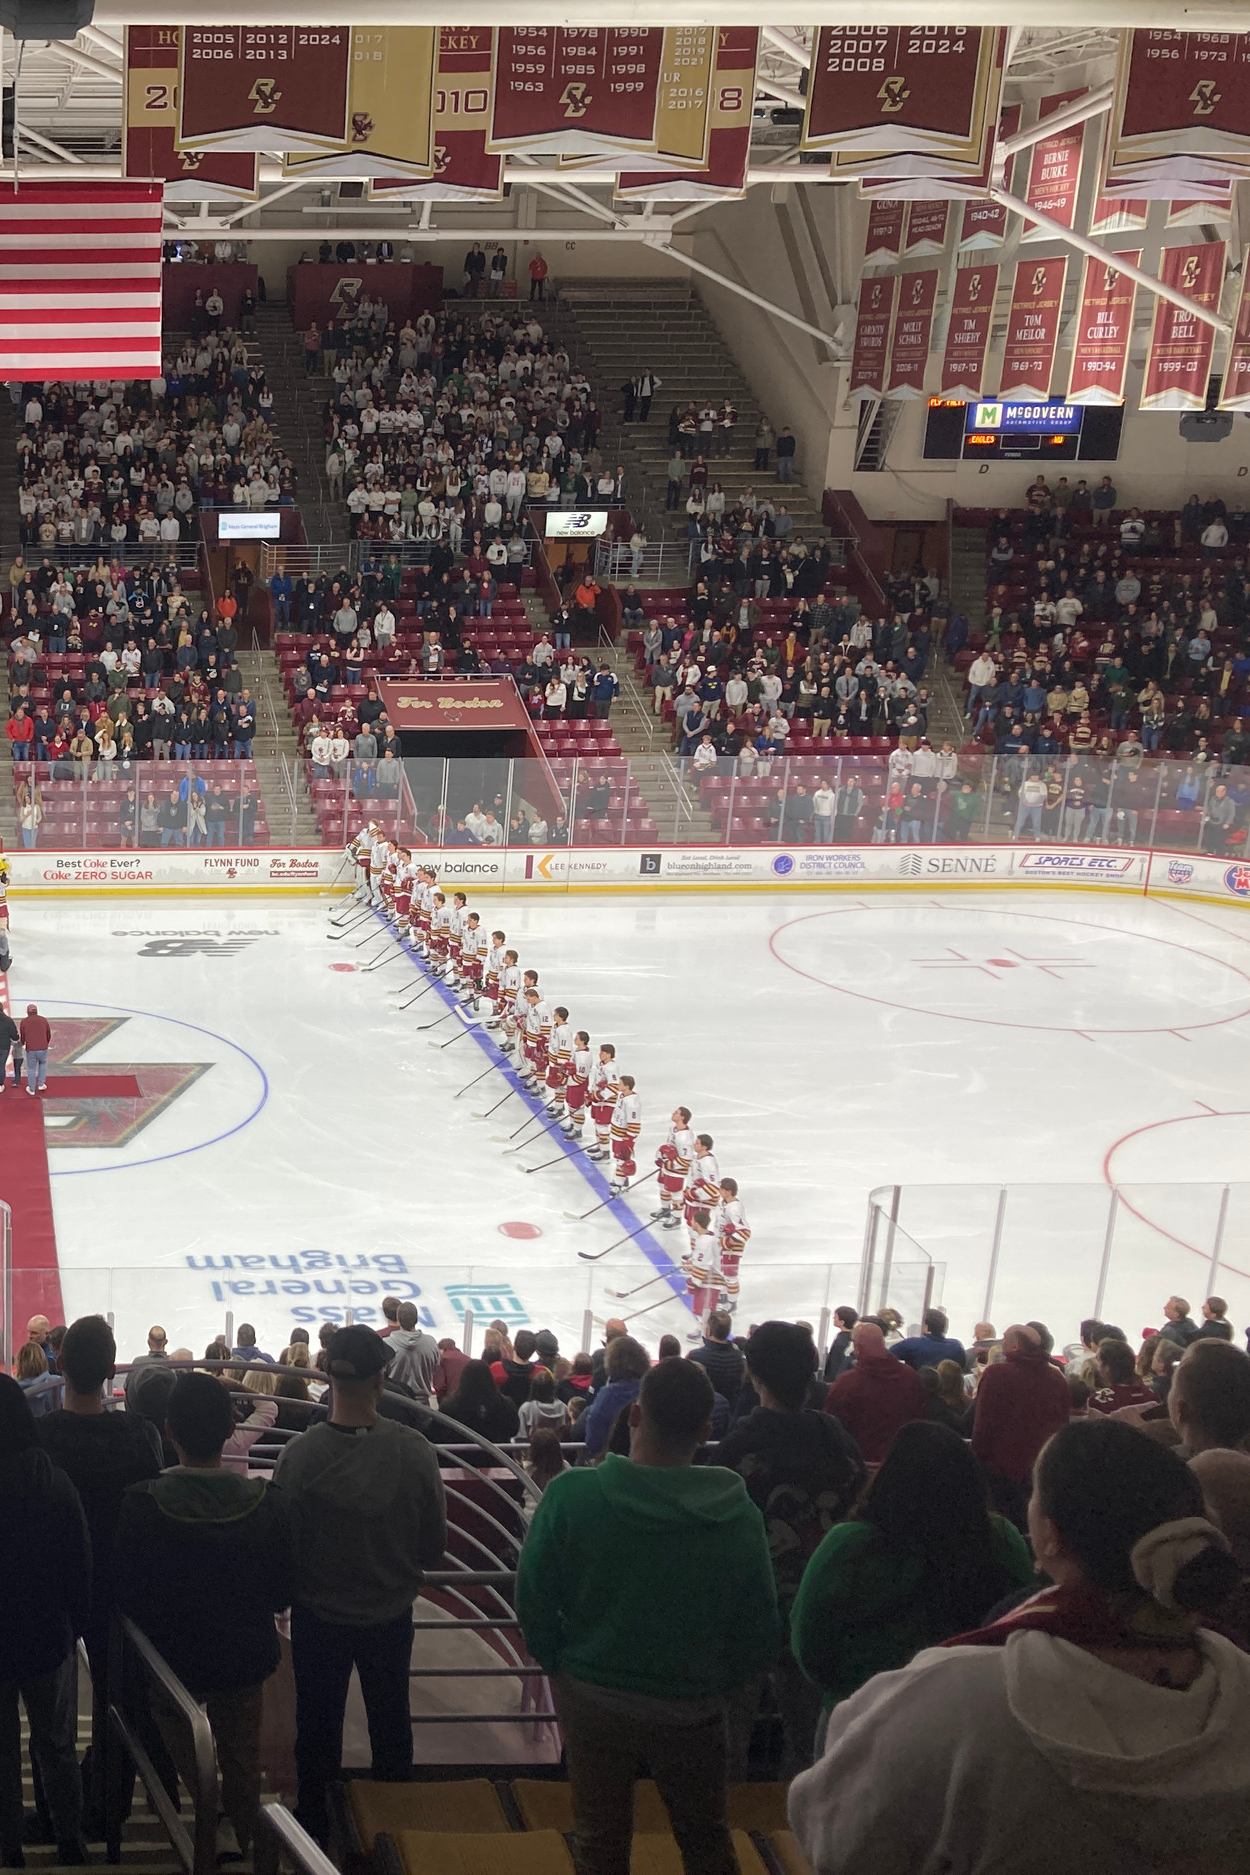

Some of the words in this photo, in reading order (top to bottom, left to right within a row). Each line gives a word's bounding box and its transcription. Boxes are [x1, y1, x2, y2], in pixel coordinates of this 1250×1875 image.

[512, 26, 548, 37] 1954
[563, 27, 598, 38] 1978
[614, 27, 649, 37] 1990
[1148, 31, 1182, 42] 1954
[1196, 33, 1230, 43] 1968
[193, 33, 235, 44] 2005
[246, 33, 288, 44] 2012
[299, 33, 341, 45] 2024
[512, 45, 546, 56] 1956
[562, 46, 597, 57] 1984
[612, 46, 644, 56] 1991
[828, 40, 888, 54] 2007
[907, 40, 966, 54] 2024
[192, 49, 234, 60] 2006
[246, 50, 288, 60] 2013
[1146, 48, 1179, 59] 1956
[1194, 50, 1227, 61] 1973
[673, 57, 704, 66] 2021
[827, 59, 885, 72] 2008
[510, 63, 545, 74] 1959
[560, 64, 595, 75] 1985
[611, 63, 646, 75] 1998
[509, 81, 544, 92] 1963
[610, 82, 644, 92] 1999
[669, 88, 704, 97] 2016
[668, 100, 703, 109] 2017
[1044, 150, 1069, 165] BERNIE
[1041, 164, 1068, 180] BURKE
[1024, 314, 1042, 326] TOM
[1096, 312, 1113, 324] BILL
[1016, 329, 1045, 341] MELLOR
[1087, 327, 1119, 339] CURLEY
[1172, 326, 1195, 338] BELL
[1082, 362, 1116, 371] 1990-94
[979, 465, 989, 473] D
[397, 697, 433, 708] For
[437, 697, 503, 708] Boston
[56, 859, 82, 868] Best
[83, 859, 108, 868] Coke
[110, 859, 141, 868] Ever?
[204, 859, 233, 867] FLYNN
[235, 859, 260, 867] FUND
[270, 859, 287, 868] For
[288, 859, 319, 868] Boston
[444, 862, 499, 873] balance
[550, 863, 565, 871] LEE
[568, 862, 607, 871] KENNEDY
[667, 861, 752, 871] blueonhighland.com
[927, 855, 997, 873] SENNÉ
[1035, 856, 1083, 867] SPORTS
[1088, 857, 1117, 868] ETC.
[43, 870, 71, 880] Coke
[74, 871, 107, 880] ZERO
[111, 871, 153, 880] SUGAR
[112, 929, 220, 937] balance
[186, 1250, 408, 1274] Brigham
[210, 1280, 421, 1302] General
